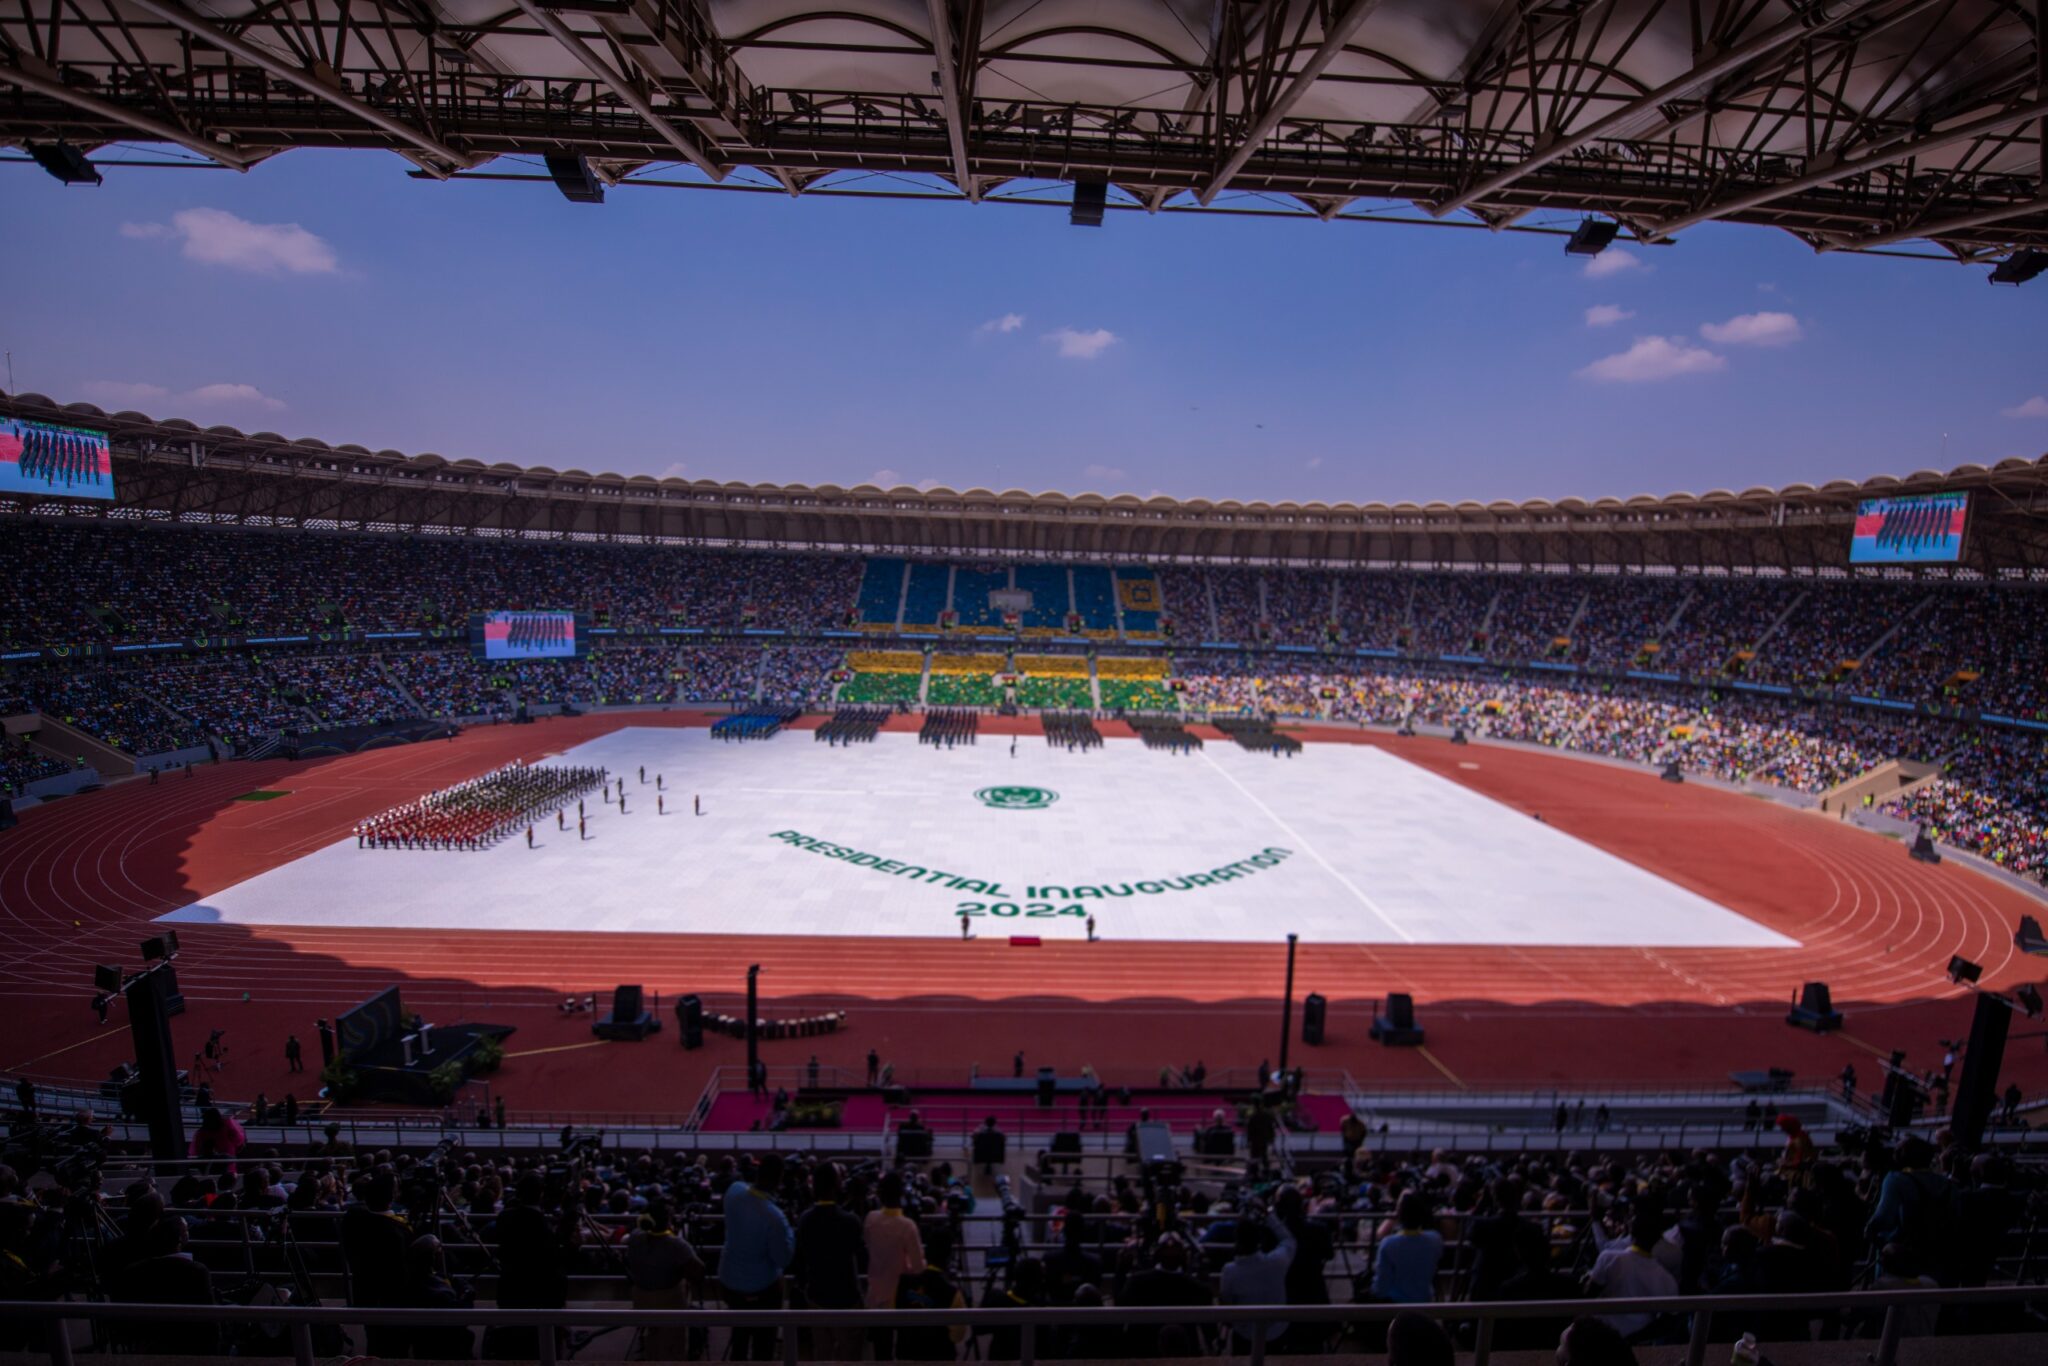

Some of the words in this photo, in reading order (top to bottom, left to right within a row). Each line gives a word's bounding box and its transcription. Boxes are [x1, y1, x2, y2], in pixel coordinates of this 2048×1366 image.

[769, 829, 1011, 898] PRESIDENTIAL
[1026, 847, 1294, 899] INAUGURATION
[955, 902, 1088, 918] 2024
